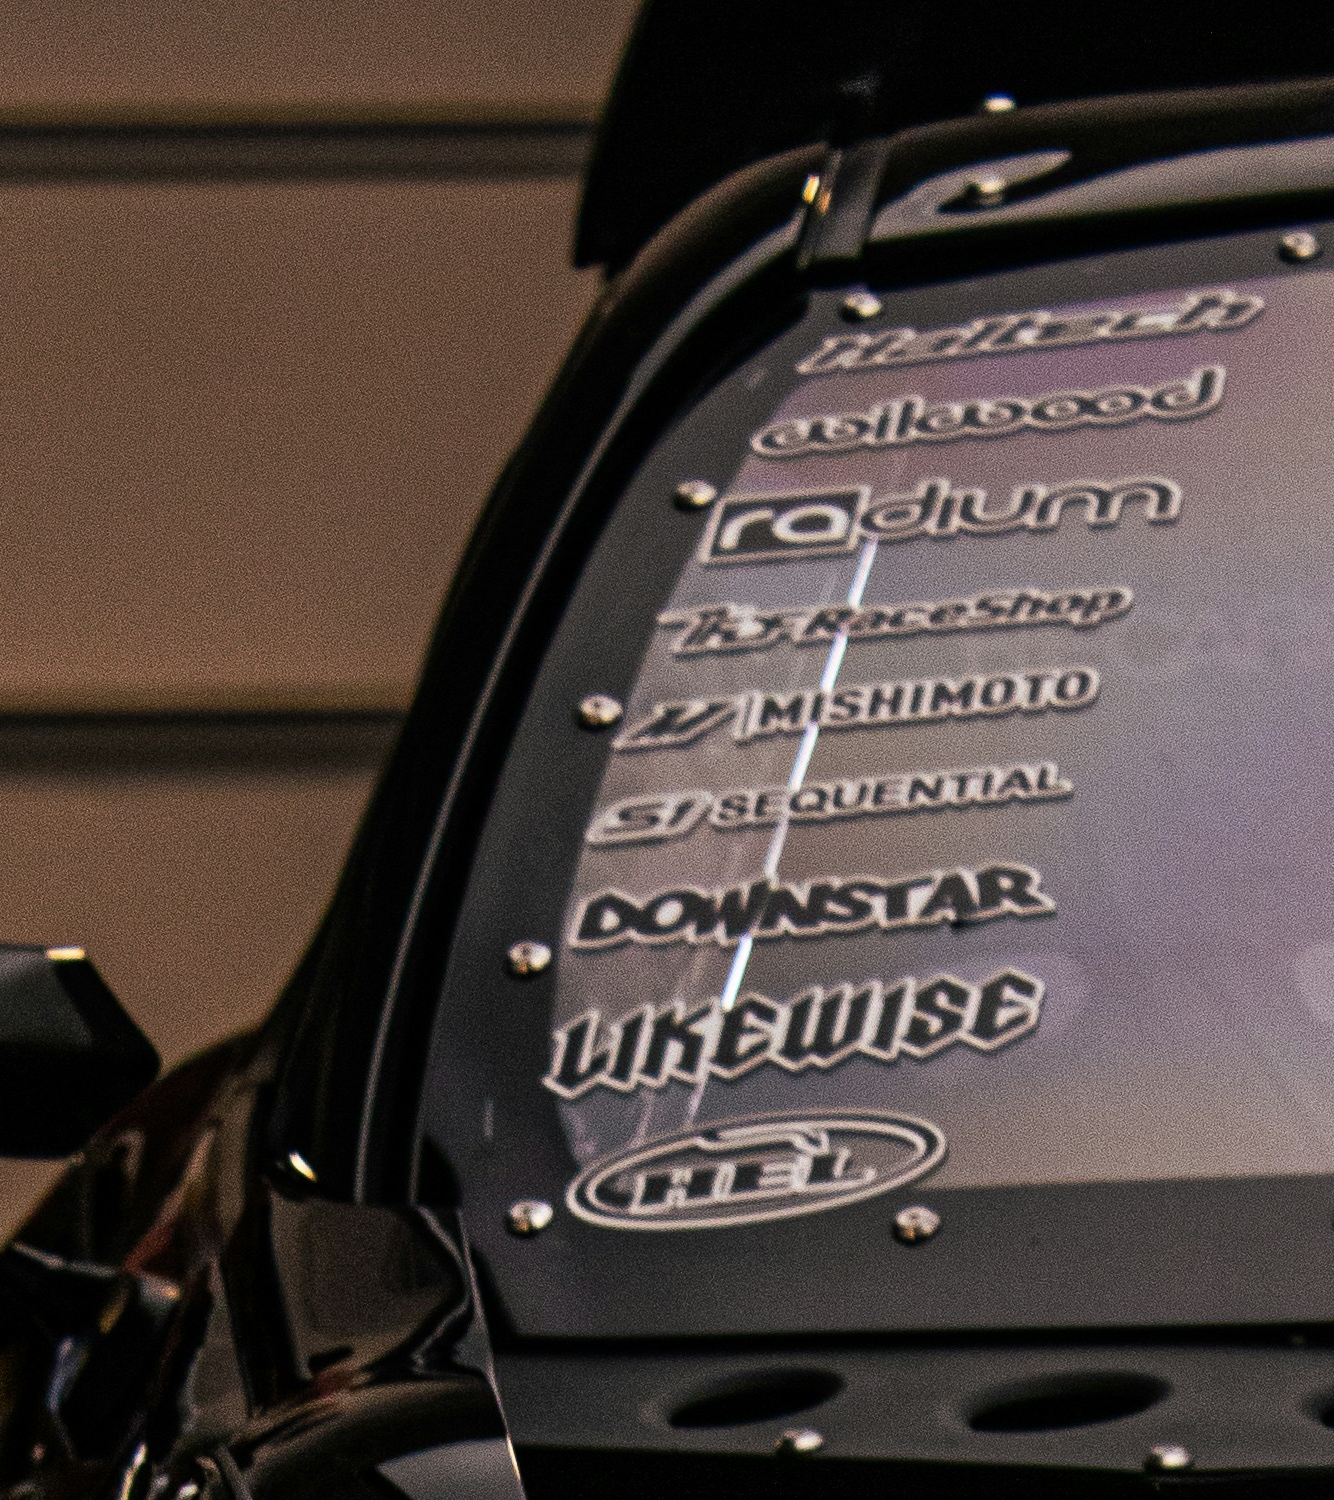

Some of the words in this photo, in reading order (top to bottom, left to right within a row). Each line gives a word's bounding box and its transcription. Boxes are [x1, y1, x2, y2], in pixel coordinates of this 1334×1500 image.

[703, 477, 1183, 562] radium
[761, 667, 1101, 731] MISHIMOTO
[708, 762, 1073, 830] SEQUENTIAL
[568, 864, 1057, 950] DOWNSTAR
[542, 968, 1045, 1100] LIKEWISE
